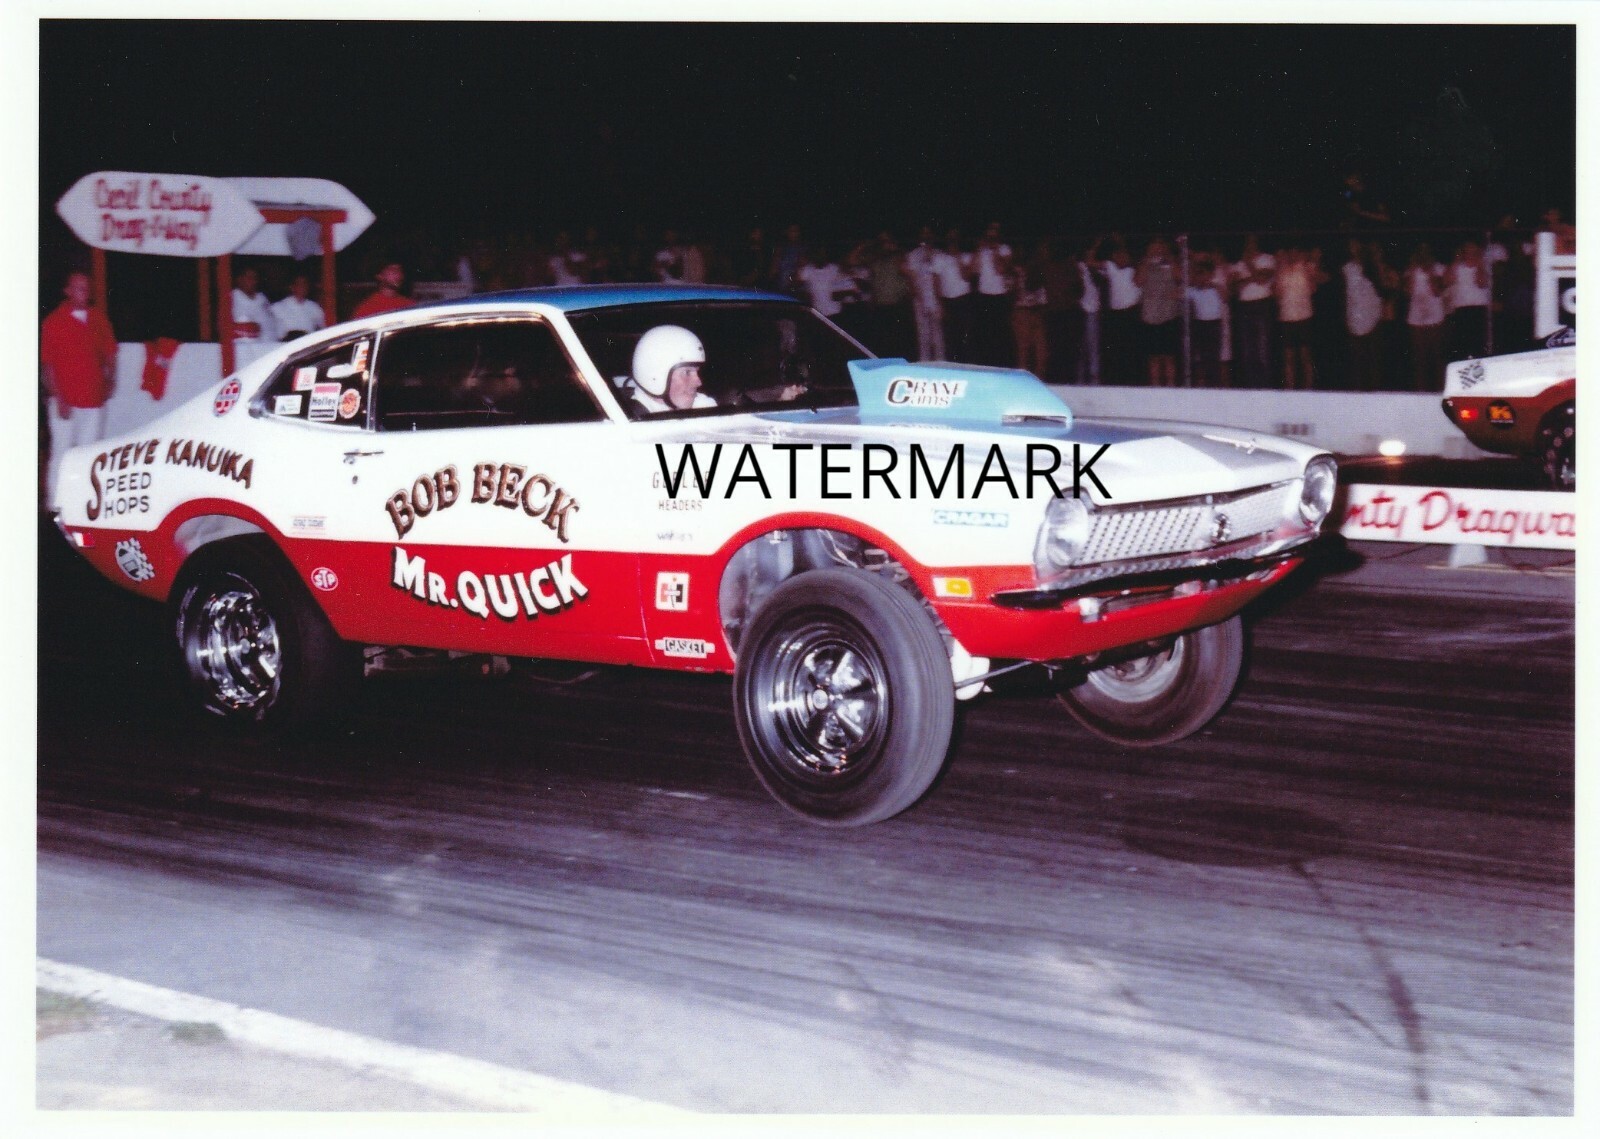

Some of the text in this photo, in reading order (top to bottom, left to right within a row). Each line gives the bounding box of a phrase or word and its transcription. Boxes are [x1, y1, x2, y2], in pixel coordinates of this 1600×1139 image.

[385, 461, 580, 543] BOB BECK
[658, 499, 702, 512] HEADERS
[313, 569, 337, 588] STP
